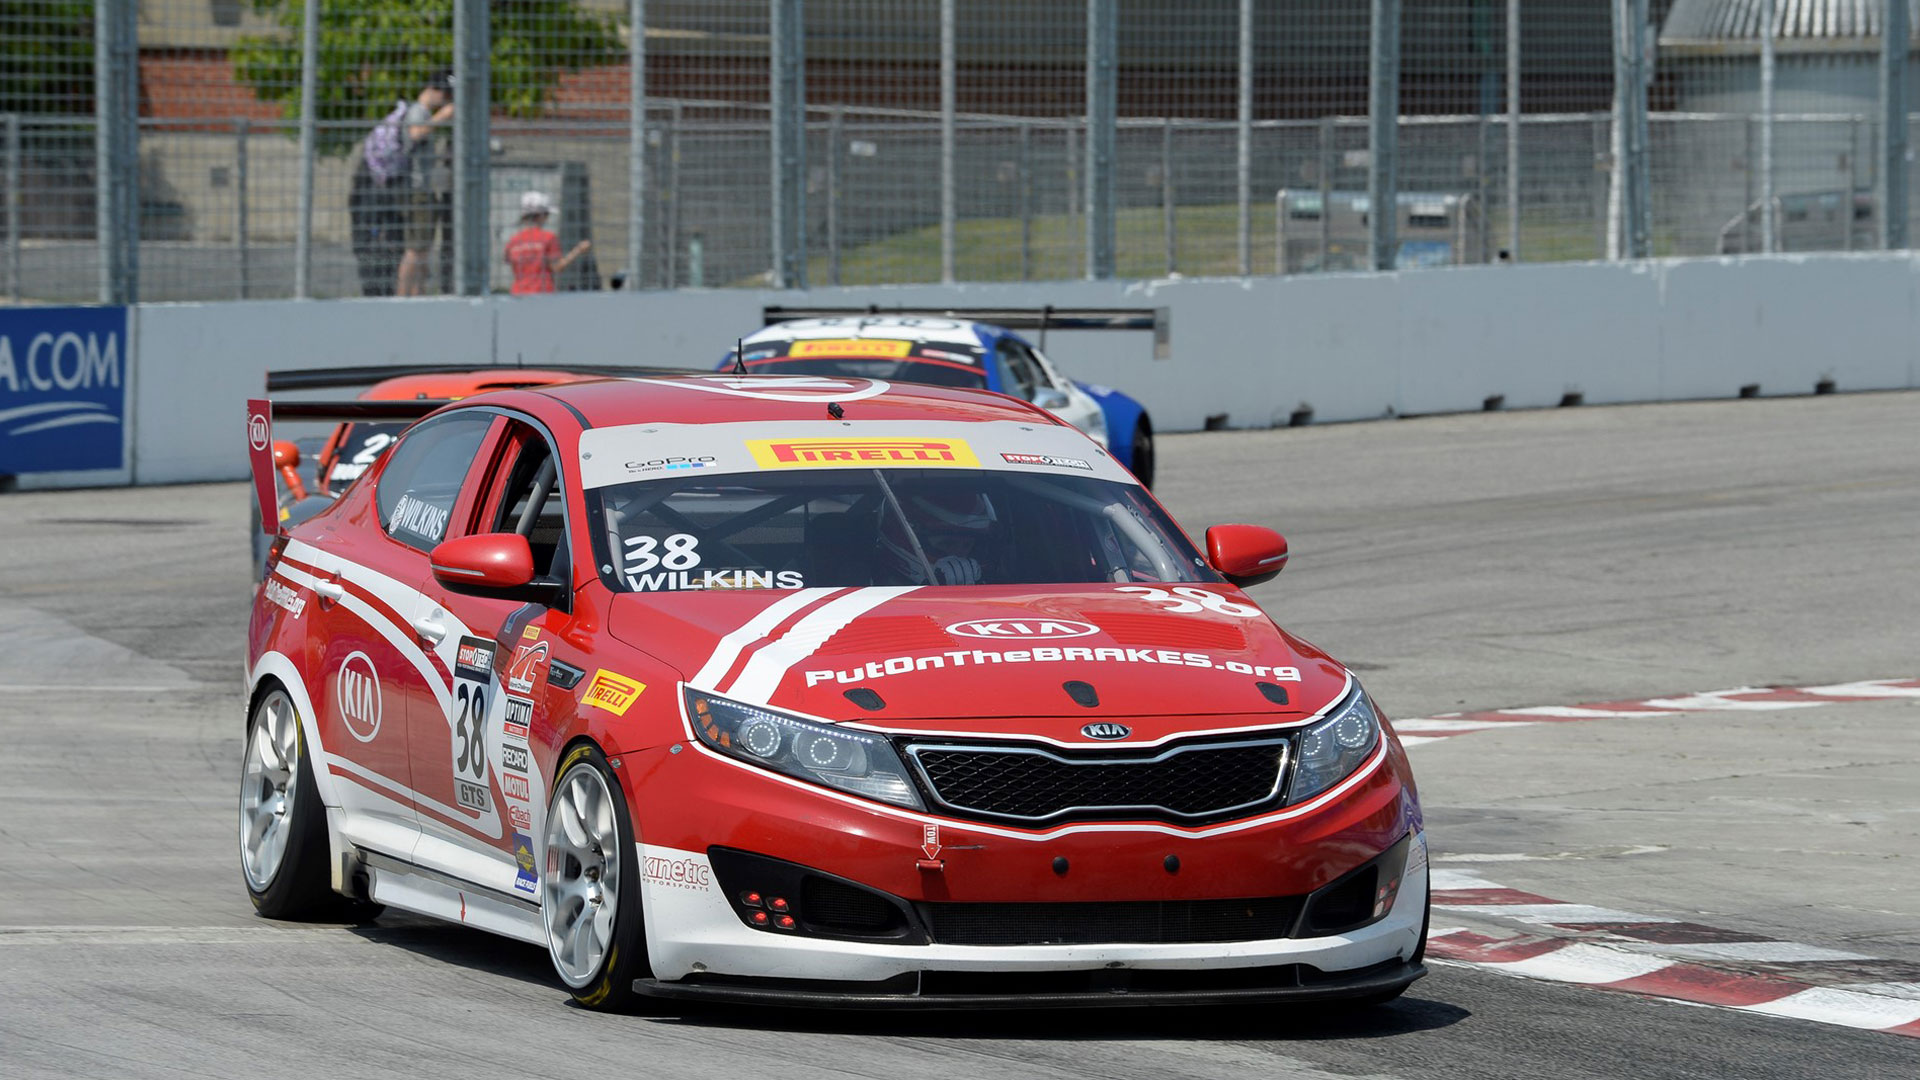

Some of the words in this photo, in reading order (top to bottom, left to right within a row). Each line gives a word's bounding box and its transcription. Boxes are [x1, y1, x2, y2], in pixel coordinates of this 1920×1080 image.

[624, 456, 716, 469] GoPro
[769, 442, 956, 463] PIRELLI
[401, 497, 448, 541] WILKINS
[623, 533, 701, 575] 38
[626, 570, 804, 592] WILKINS
[1113, 586, 1263, 617] 38
[972, 619, 1077, 637] KIA
[804, 646, 1302, 689] PutOnTheBRAKES.org
[588, 675, 636, 708] PIRELLI
[506, 701, 531, 724] OPTIMA
[456, 682, 485, 779] 38
[1088, 724, 1126, 736] KIA
[503, 747, 528, 769] RECARO
[461, 784, 485, 807] GTS
[504, 775, 529, 800] MOTUL
[926, 826, 937, 844] TOW
[642, 878, 709, 893] MOTORSPORTS
